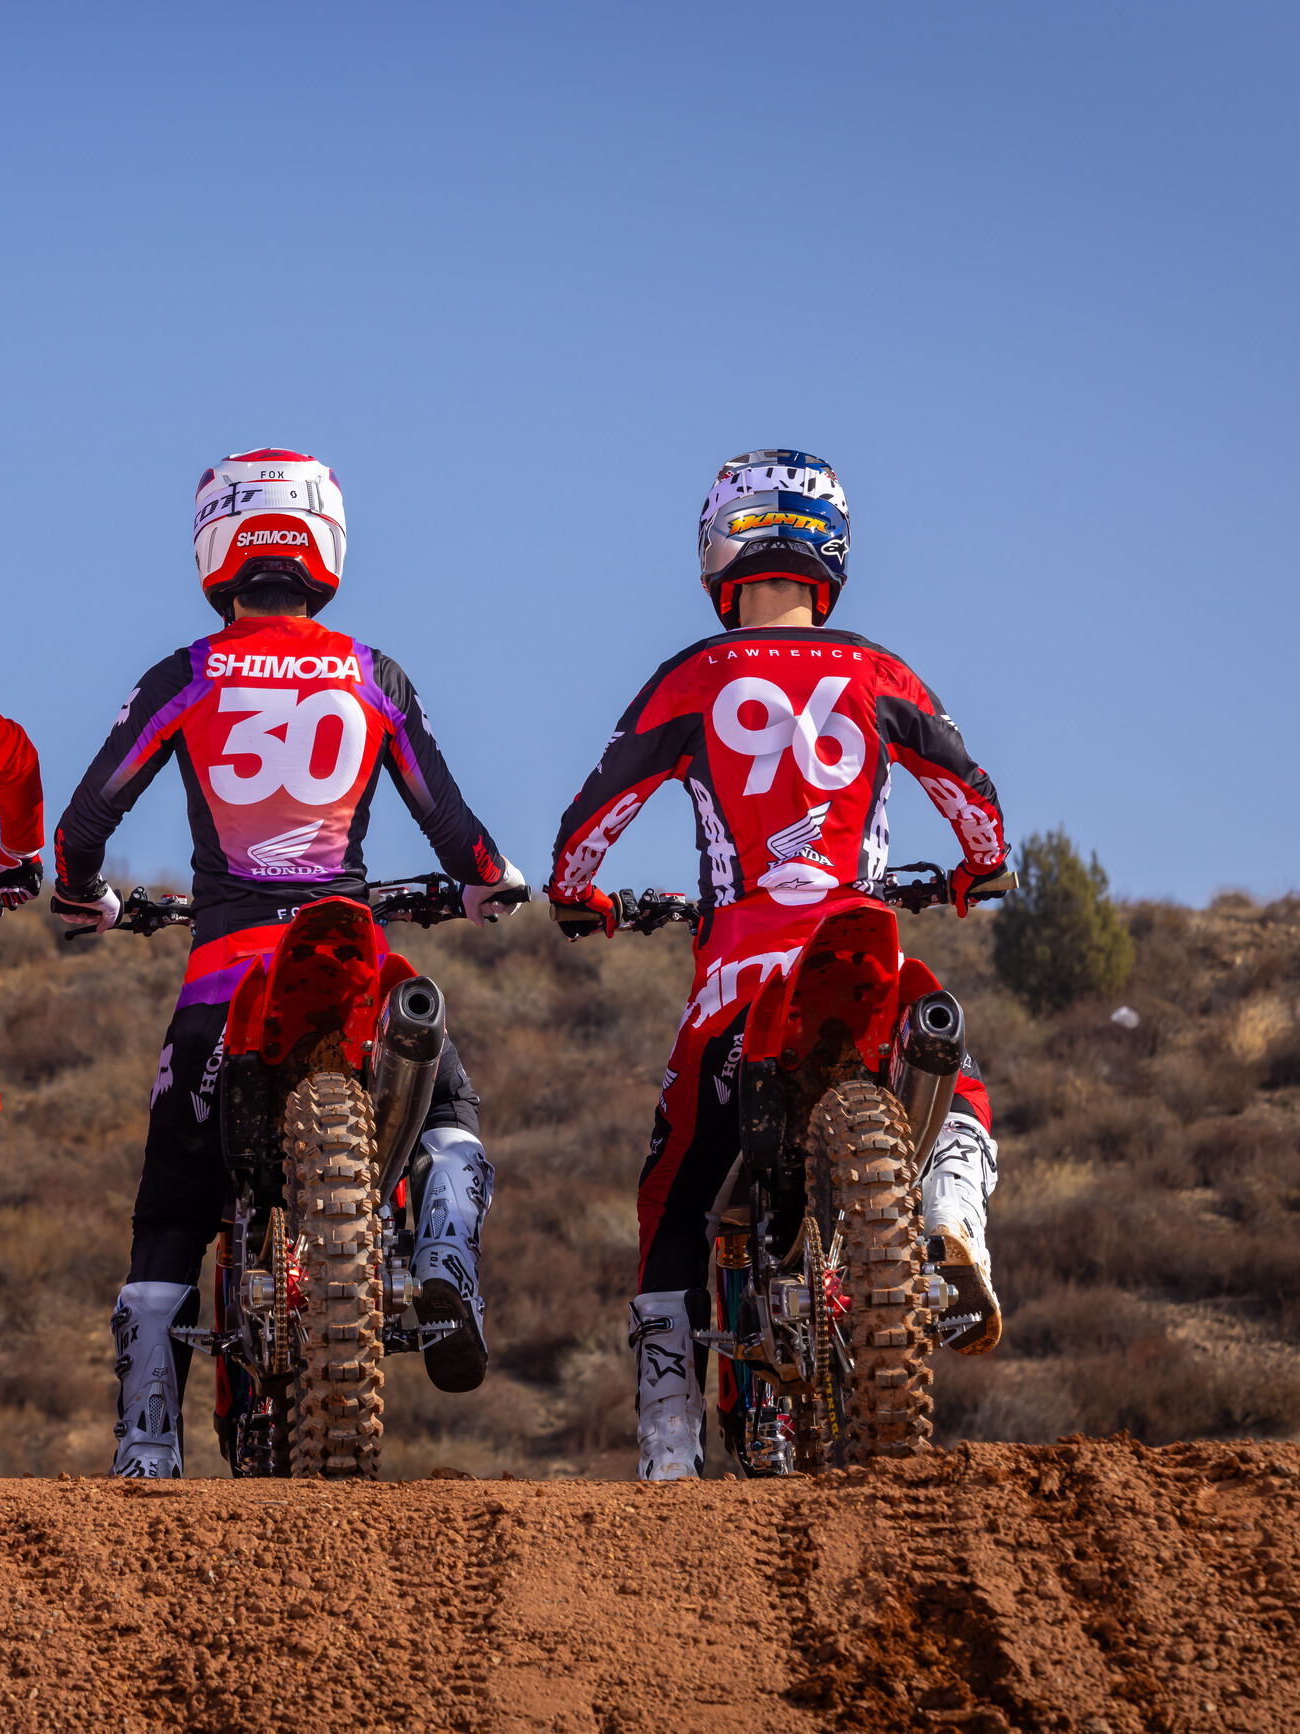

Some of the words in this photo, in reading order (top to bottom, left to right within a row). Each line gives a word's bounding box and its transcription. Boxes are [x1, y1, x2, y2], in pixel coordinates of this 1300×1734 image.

[260, 470, 285, 479] FOX
[236, 530, 309, 547] SHIMODA
[708, 649, 863, 665] LAWRENCE
[205, 652, 363, 683] SHIMODA
[712, 676, 866, 796] 96
[208, 686, 368, 806] 30
[250, 865, 329, 876] HONDA
[277, 906, 300, 919] FO
[430, 1250, 439, 1268] FOX
[149, 1460, 158, 1478] OX
